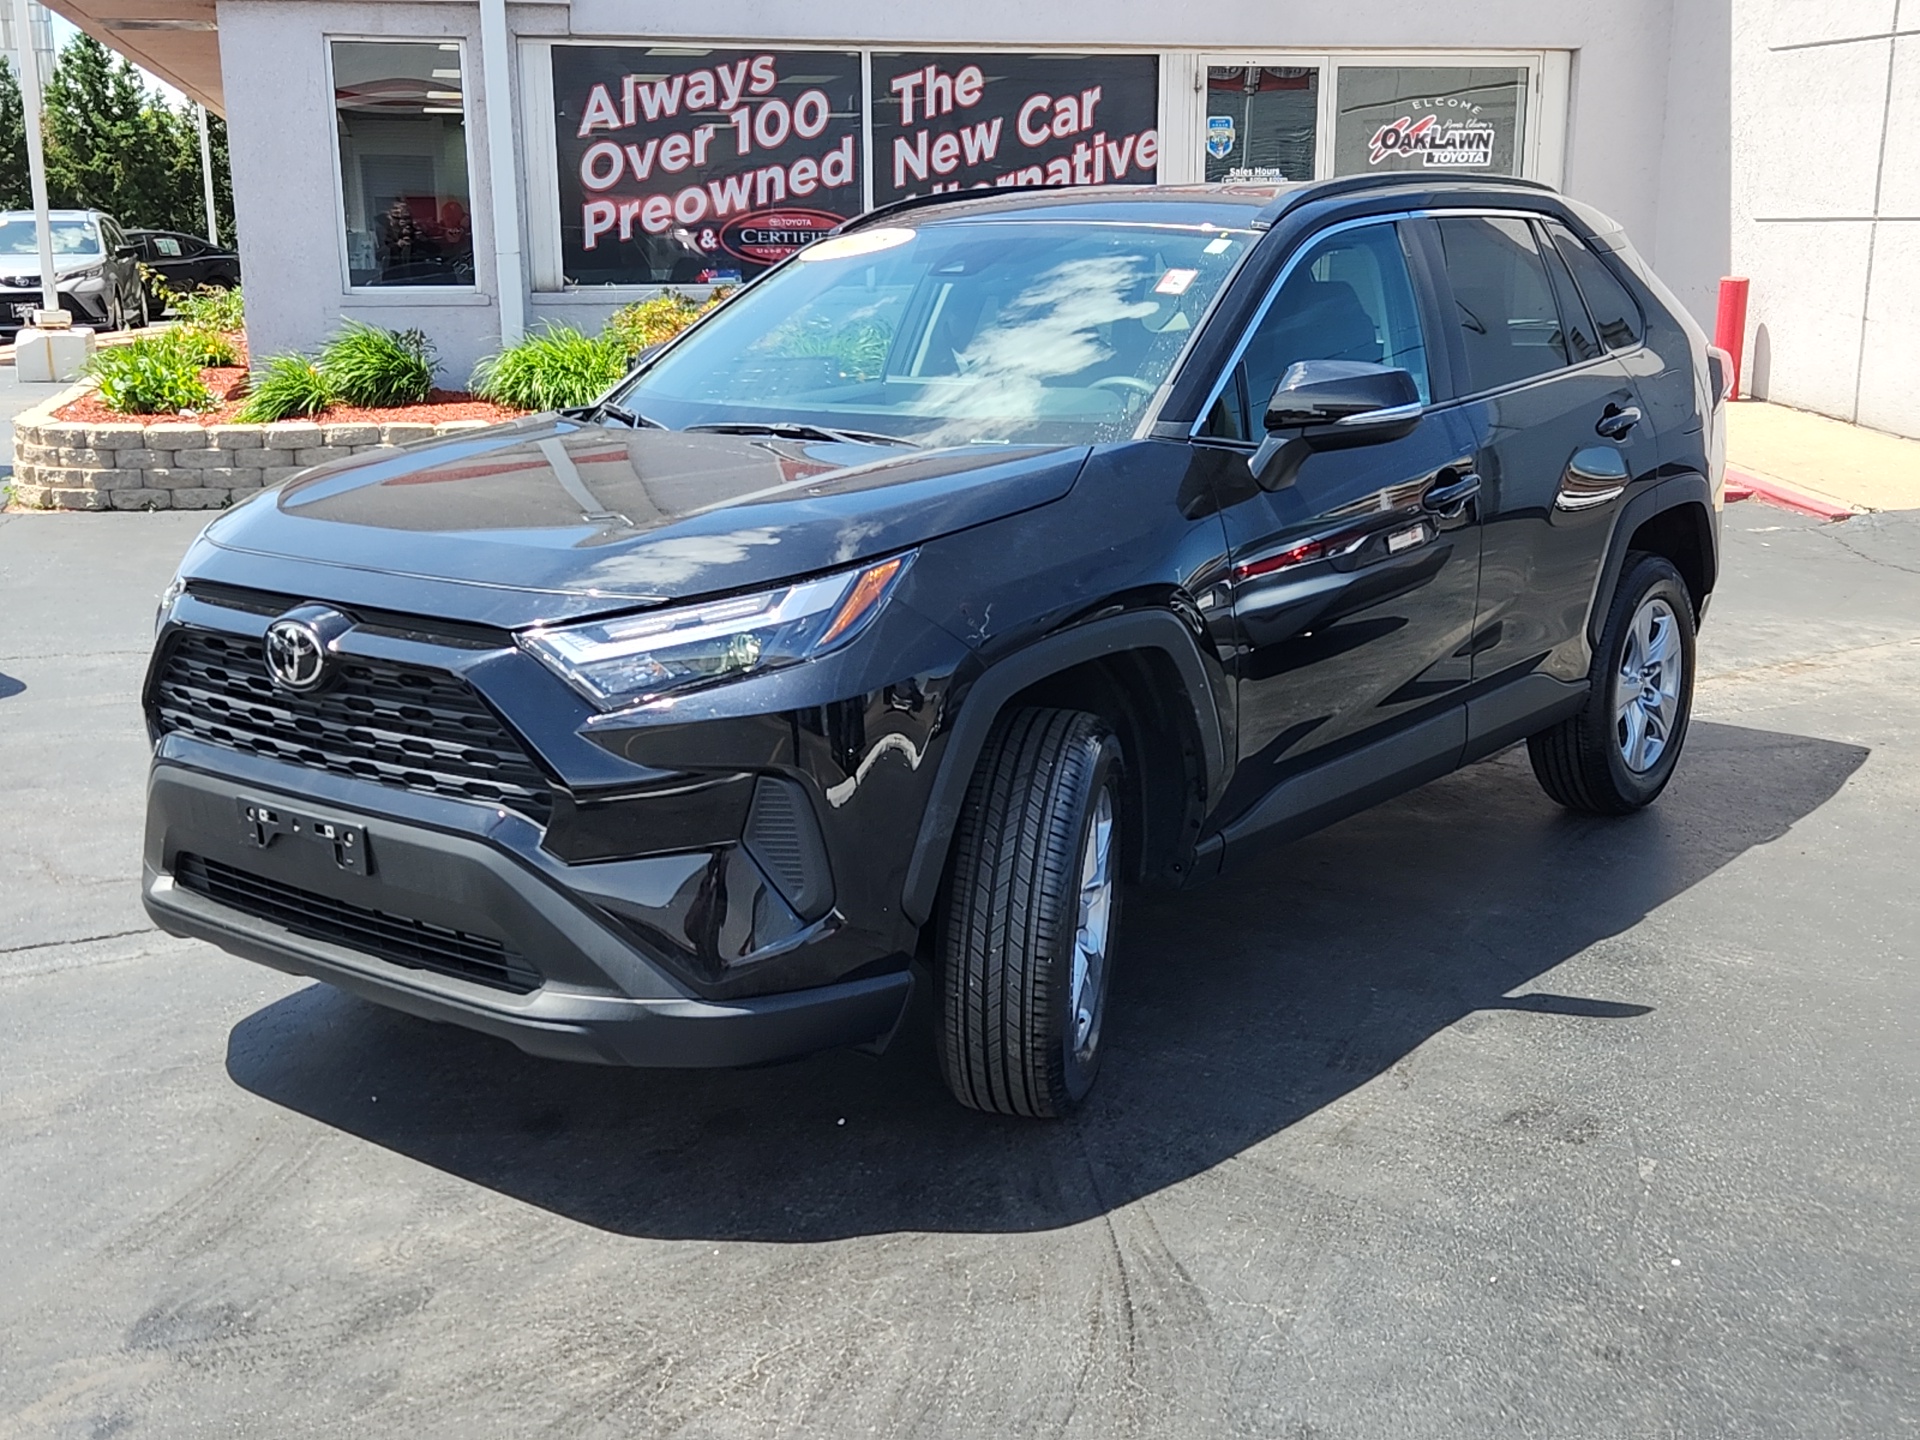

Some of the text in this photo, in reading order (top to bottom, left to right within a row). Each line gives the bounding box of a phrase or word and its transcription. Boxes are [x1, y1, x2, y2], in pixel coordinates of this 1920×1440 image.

[578, 55, 776, 137] Always
[891, 64, 984, 125] The
[581, 89, 829, 191] Over 100
[893, 86, 1101, 188] New Car
[1432, 152, 1484, 163] TOYOTA
[583, 135, 853, 249] Preowned
[1230, 166, 1280, 176] Sales Hours
[700, 228, 718, 248] &
[782, 218, 812, 226] TOYOTA
